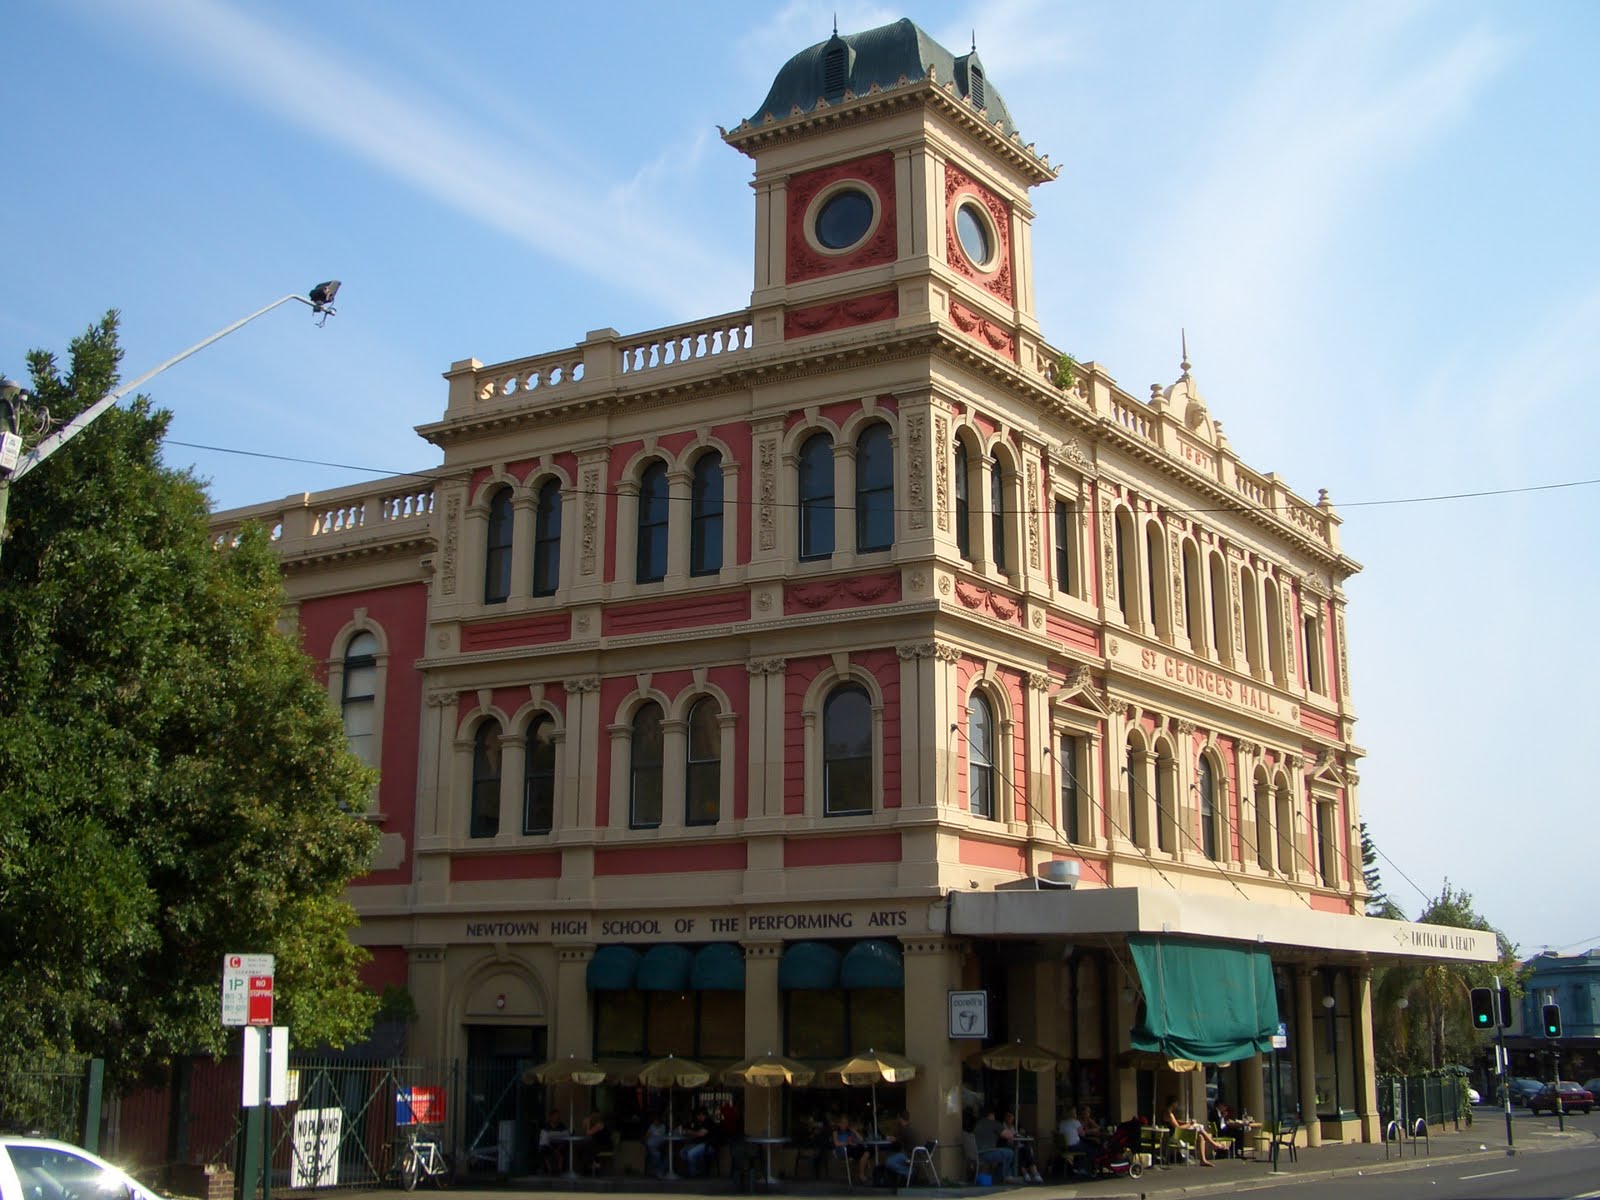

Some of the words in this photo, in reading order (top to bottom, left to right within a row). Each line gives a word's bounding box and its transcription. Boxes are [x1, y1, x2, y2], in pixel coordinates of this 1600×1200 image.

[1164, 656, 1233, 699] GEORGE'S
[466, 922, 539, 937] NEWTOWN
[551, 920, 587, 935] HIGH
[602, 919, 662, 935] SCHOOL
[674, 919, 695, 934] OF
[710, 918, 740, 932] THE
[750, 912, 853, 930] PERFORMING
[868, 911, 907, 927] ARTS
[229, 978, 244, 991] 1P
[255, 979, 267, 988] NO
[298, 1120, 307, 1138] NO
[308, 1118, 339, 1136] PAKING
